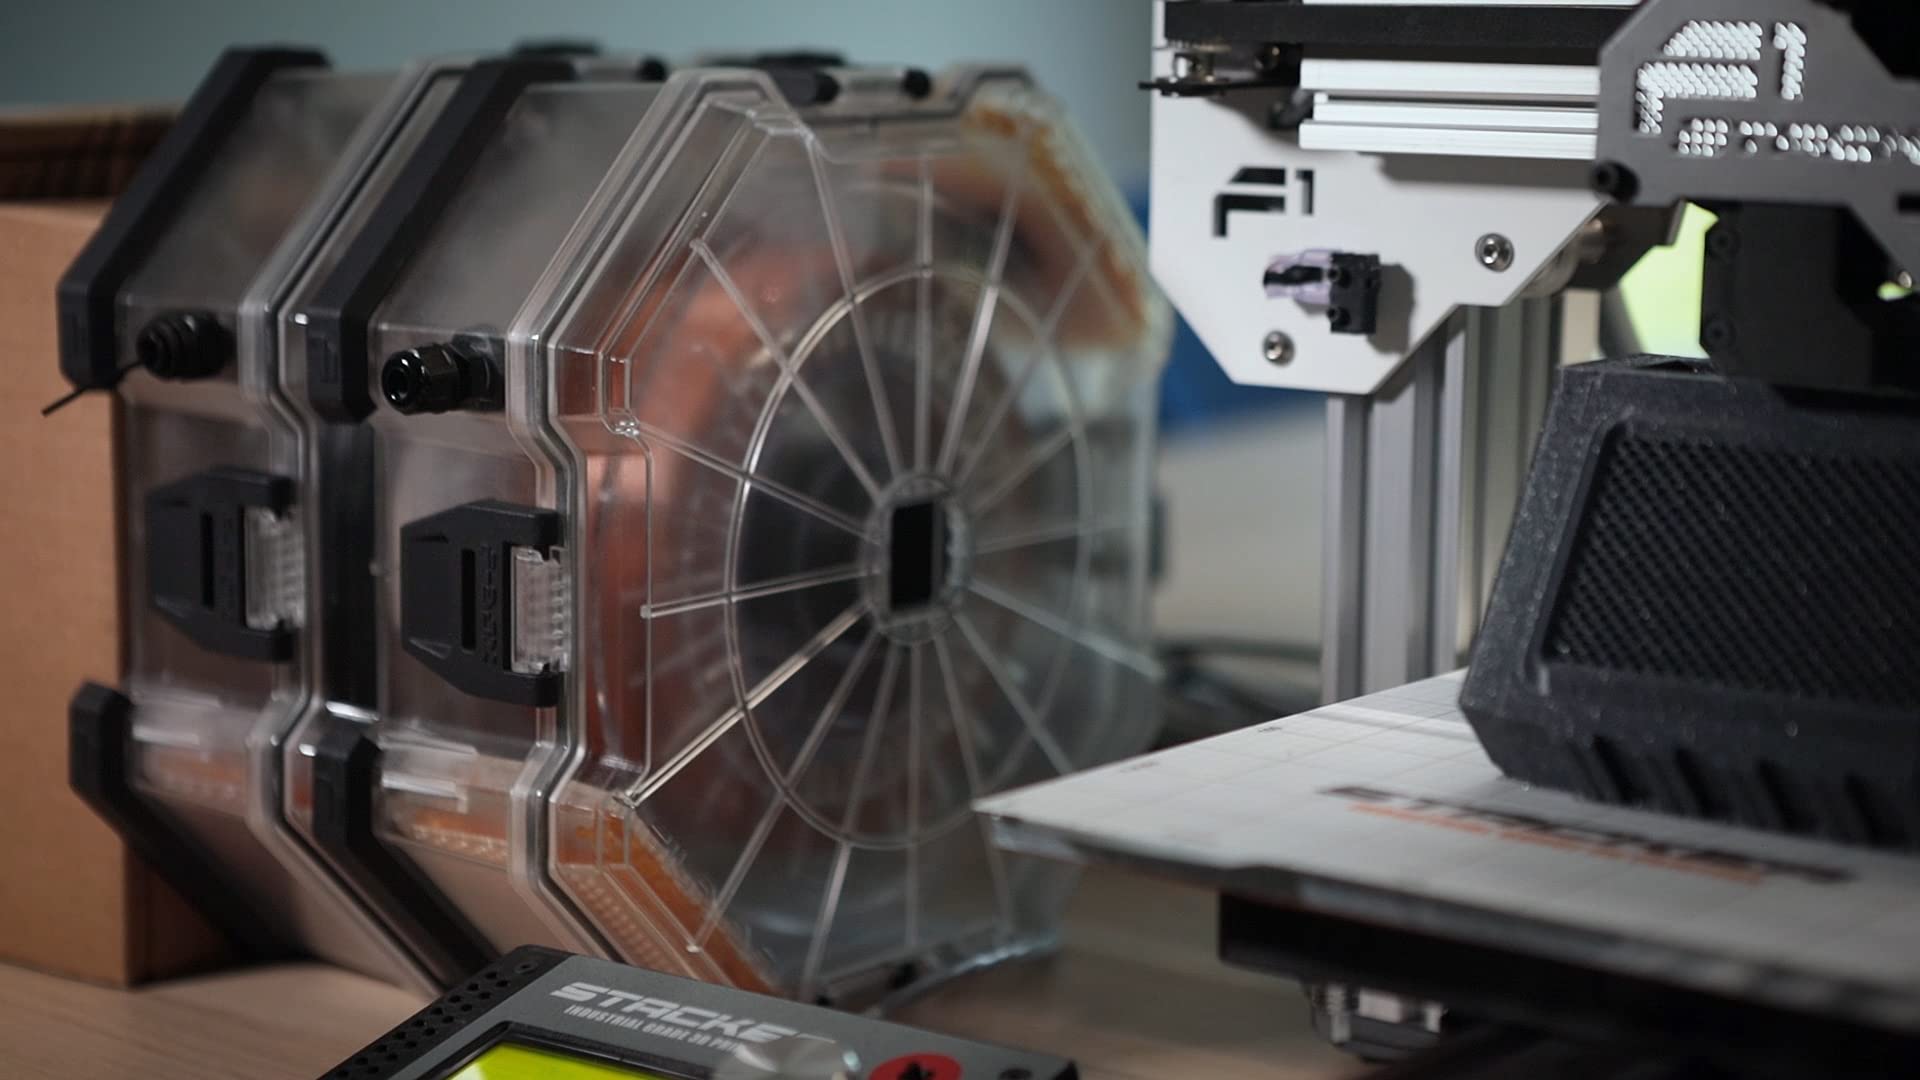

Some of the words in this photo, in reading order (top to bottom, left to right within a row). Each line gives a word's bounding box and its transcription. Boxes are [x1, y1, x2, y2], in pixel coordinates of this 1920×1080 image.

[550, 982, 835, 1043] STACKE
[564, 1004, 645, 1031] INDUSTRIAL
[642, 1023, 690, 1041] GRADE
